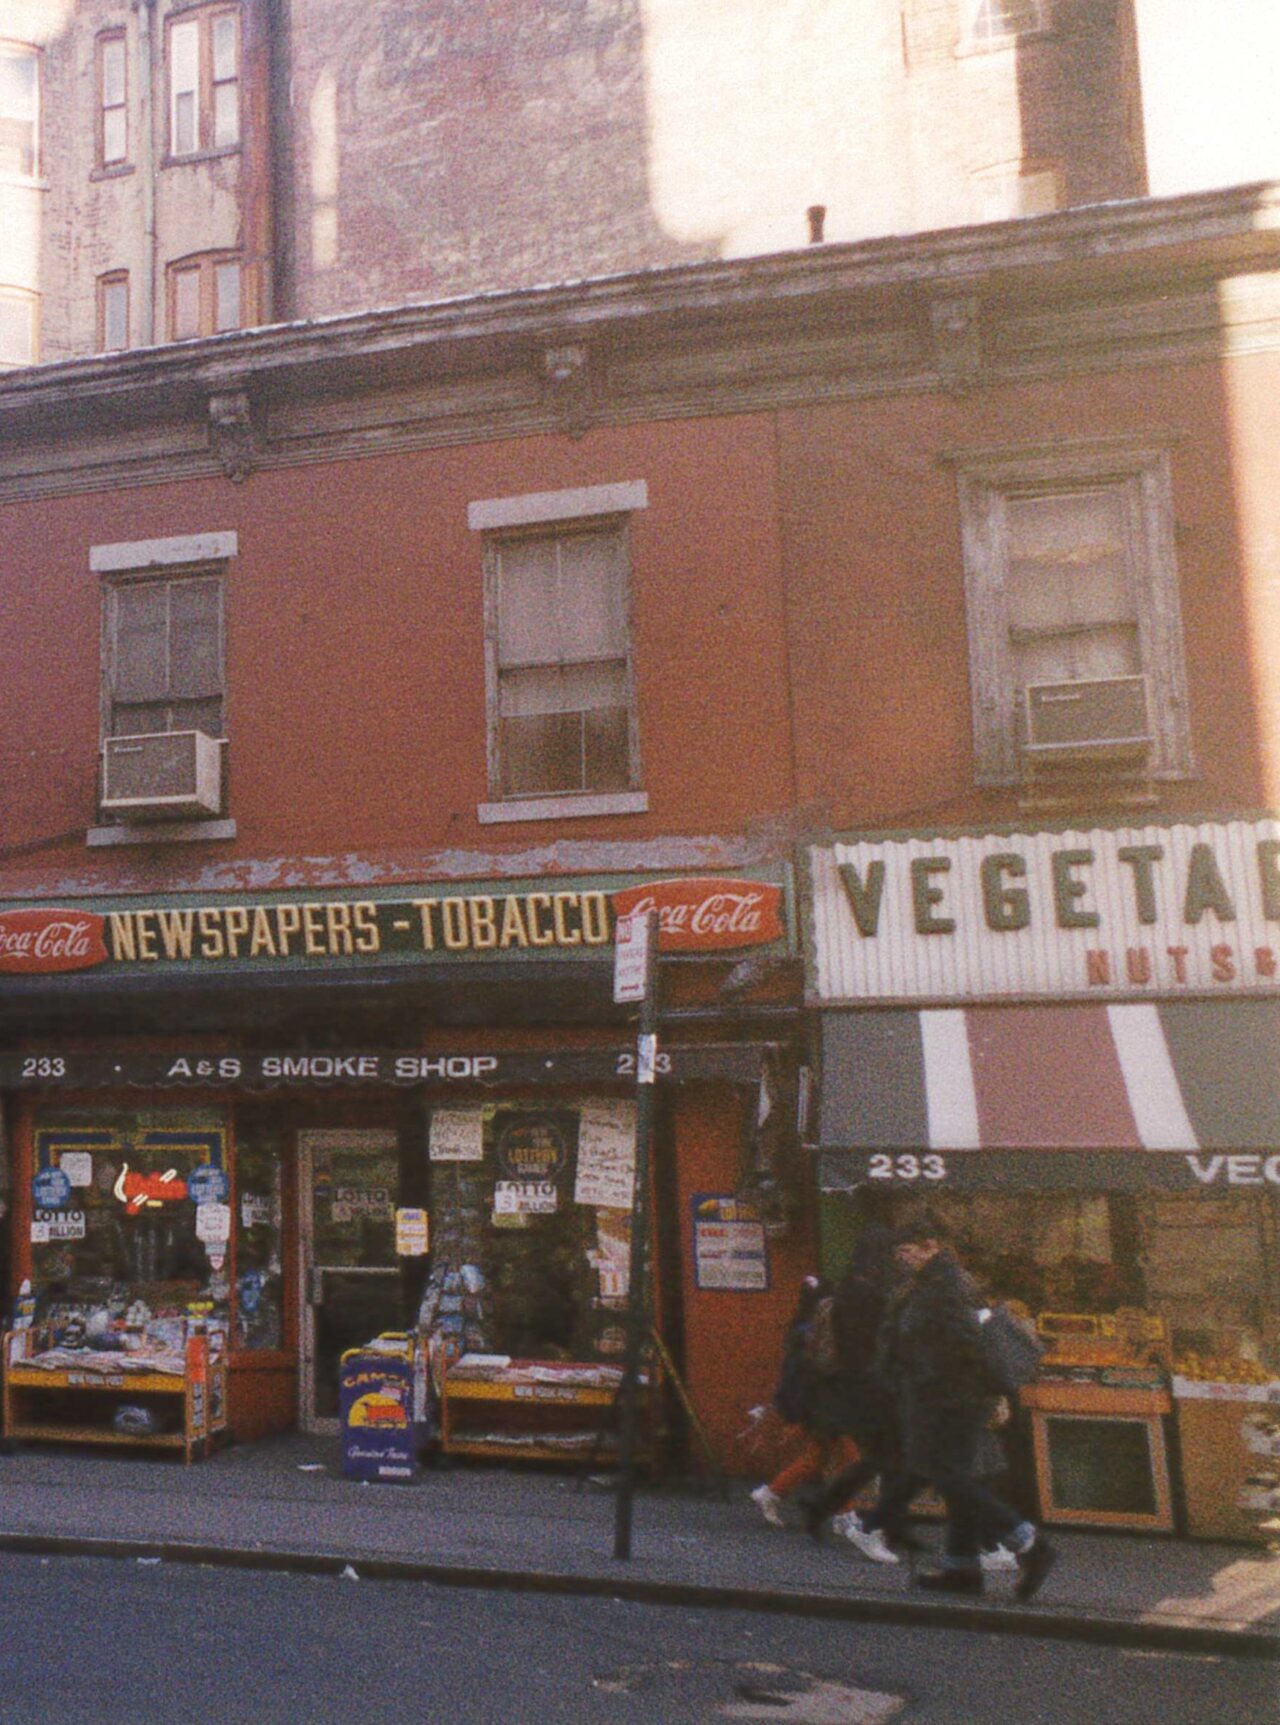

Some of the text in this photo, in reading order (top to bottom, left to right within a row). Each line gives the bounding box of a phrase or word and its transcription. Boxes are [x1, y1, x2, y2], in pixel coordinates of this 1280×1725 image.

[629, 892, 764, 934] Cca-Cola
[109, 900, 381, 961] NEWSPAPERS
[22, 1057, 66, 1077] 233
[167, 1057, 242, 1078] A&S
[261, 1056, 379, 1078] SMOKE
[394, 1056, 499, 1079] SHOP
[616, 1053, 672, 1074] 23
[868, 1153, 947, 1180] 233
[33, 1209, 83, 1222] LOTTO
